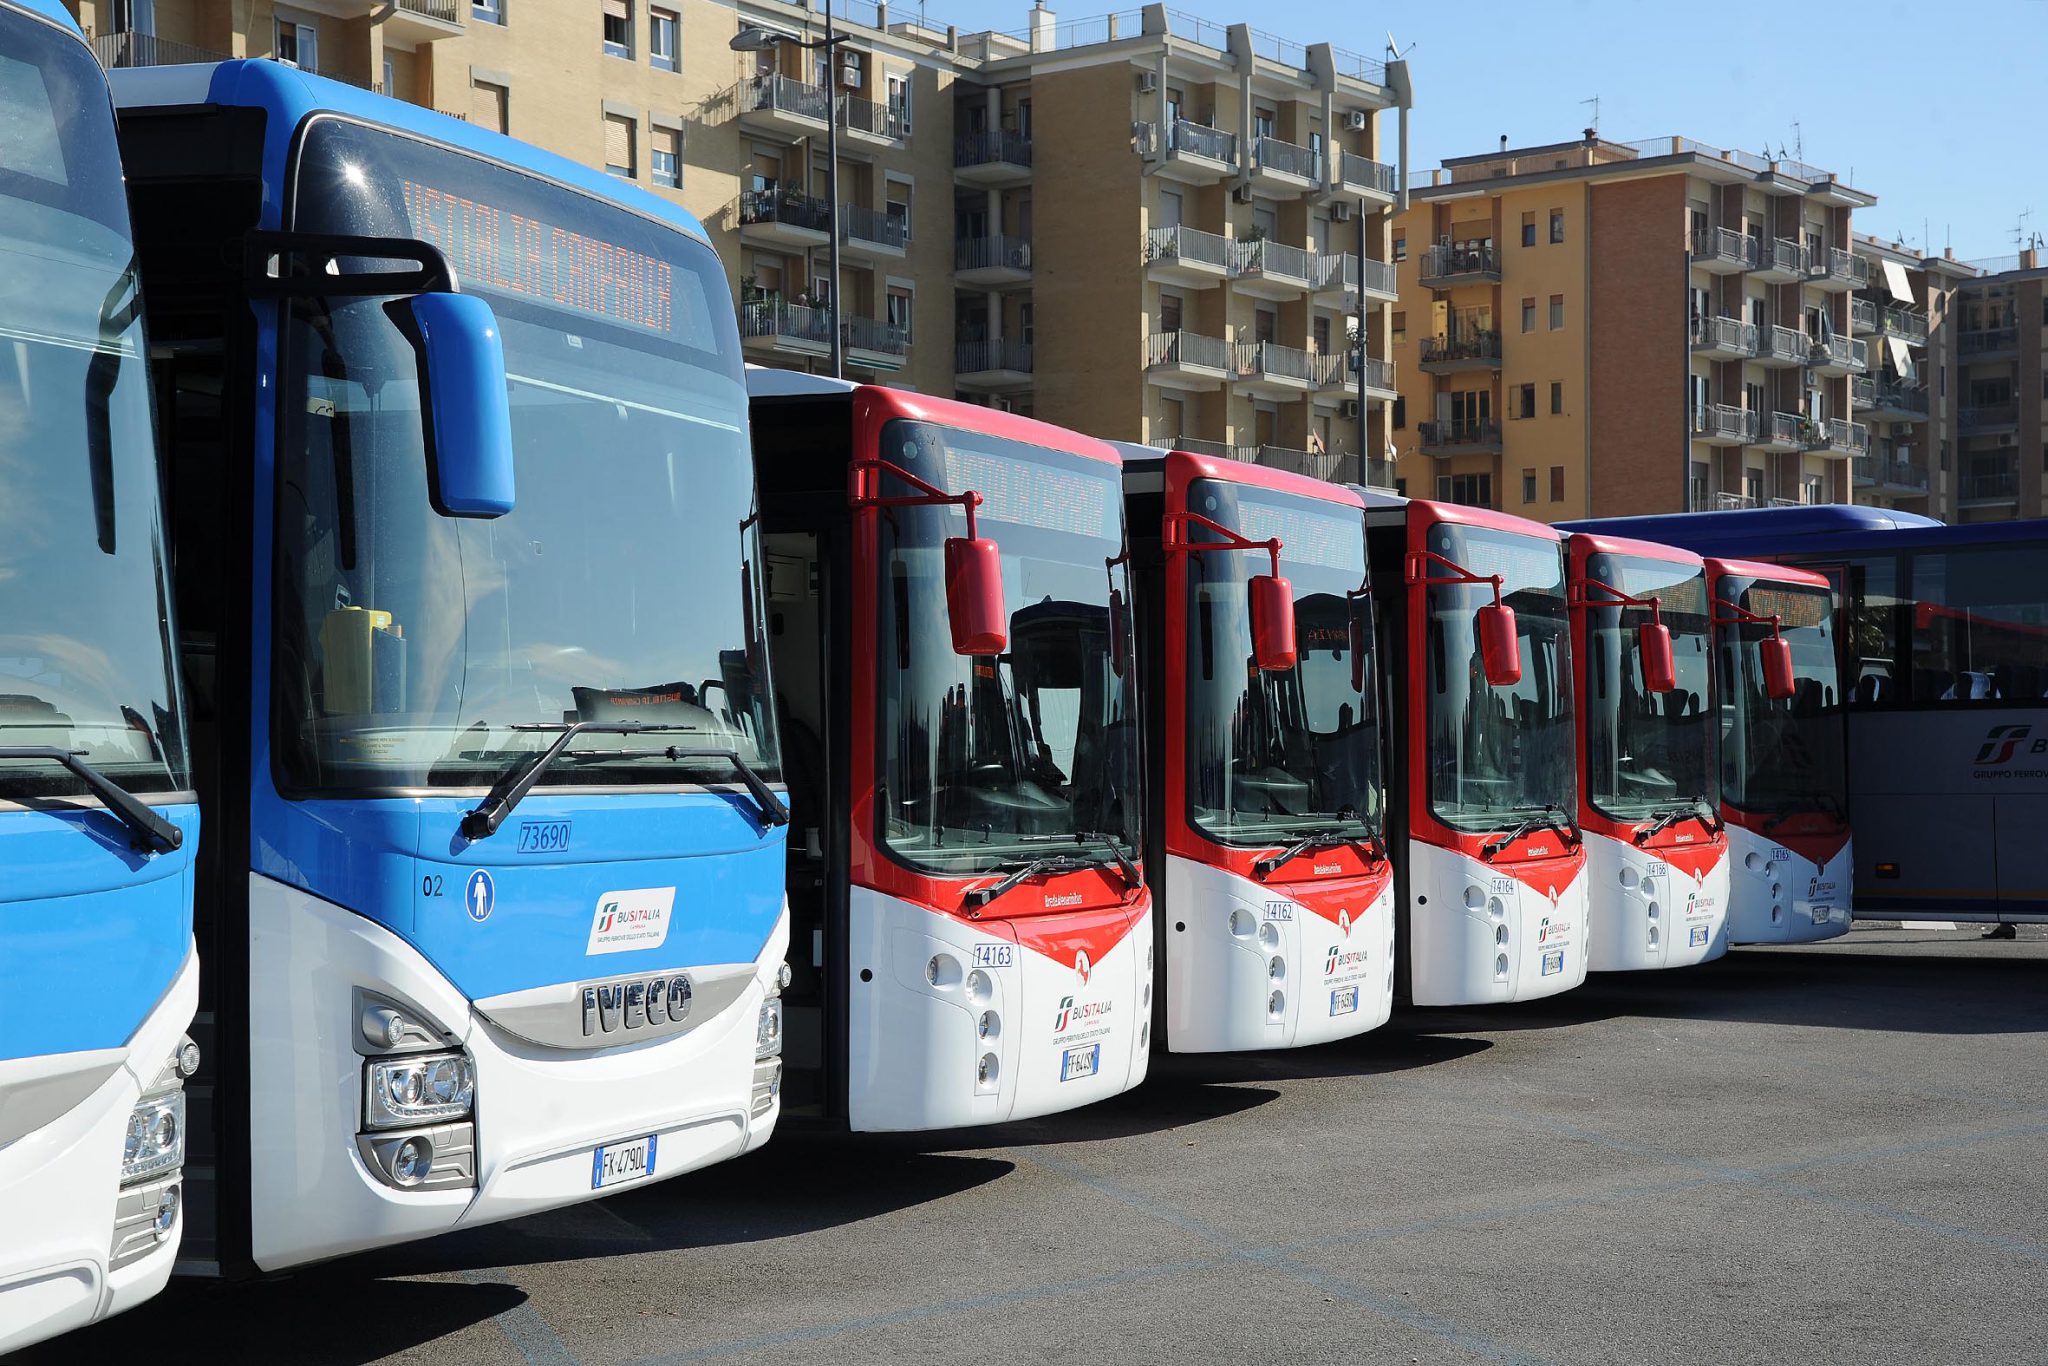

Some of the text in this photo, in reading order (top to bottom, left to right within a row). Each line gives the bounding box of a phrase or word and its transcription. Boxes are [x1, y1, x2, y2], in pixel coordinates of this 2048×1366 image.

[552, 227, 671, 332] CAMPANIA
[1973, 769, 2012, 779] GRUPPO
[521, 824, 569, 850] 73690
[423, 874, 443, 897] 02
[1493, 879, 1514, 893] 14164
[617, 909, 660, 923] BUSITALIA
[1266, 903, 1292, 919] 14162
[976, 946, 1011, 966] 14163
[1338, 950, 1367, 966] BUSITALIA
[582, 975, 691, 1036] IVECO
[1072, 1000, 1112, 1020] BUSITALIA
